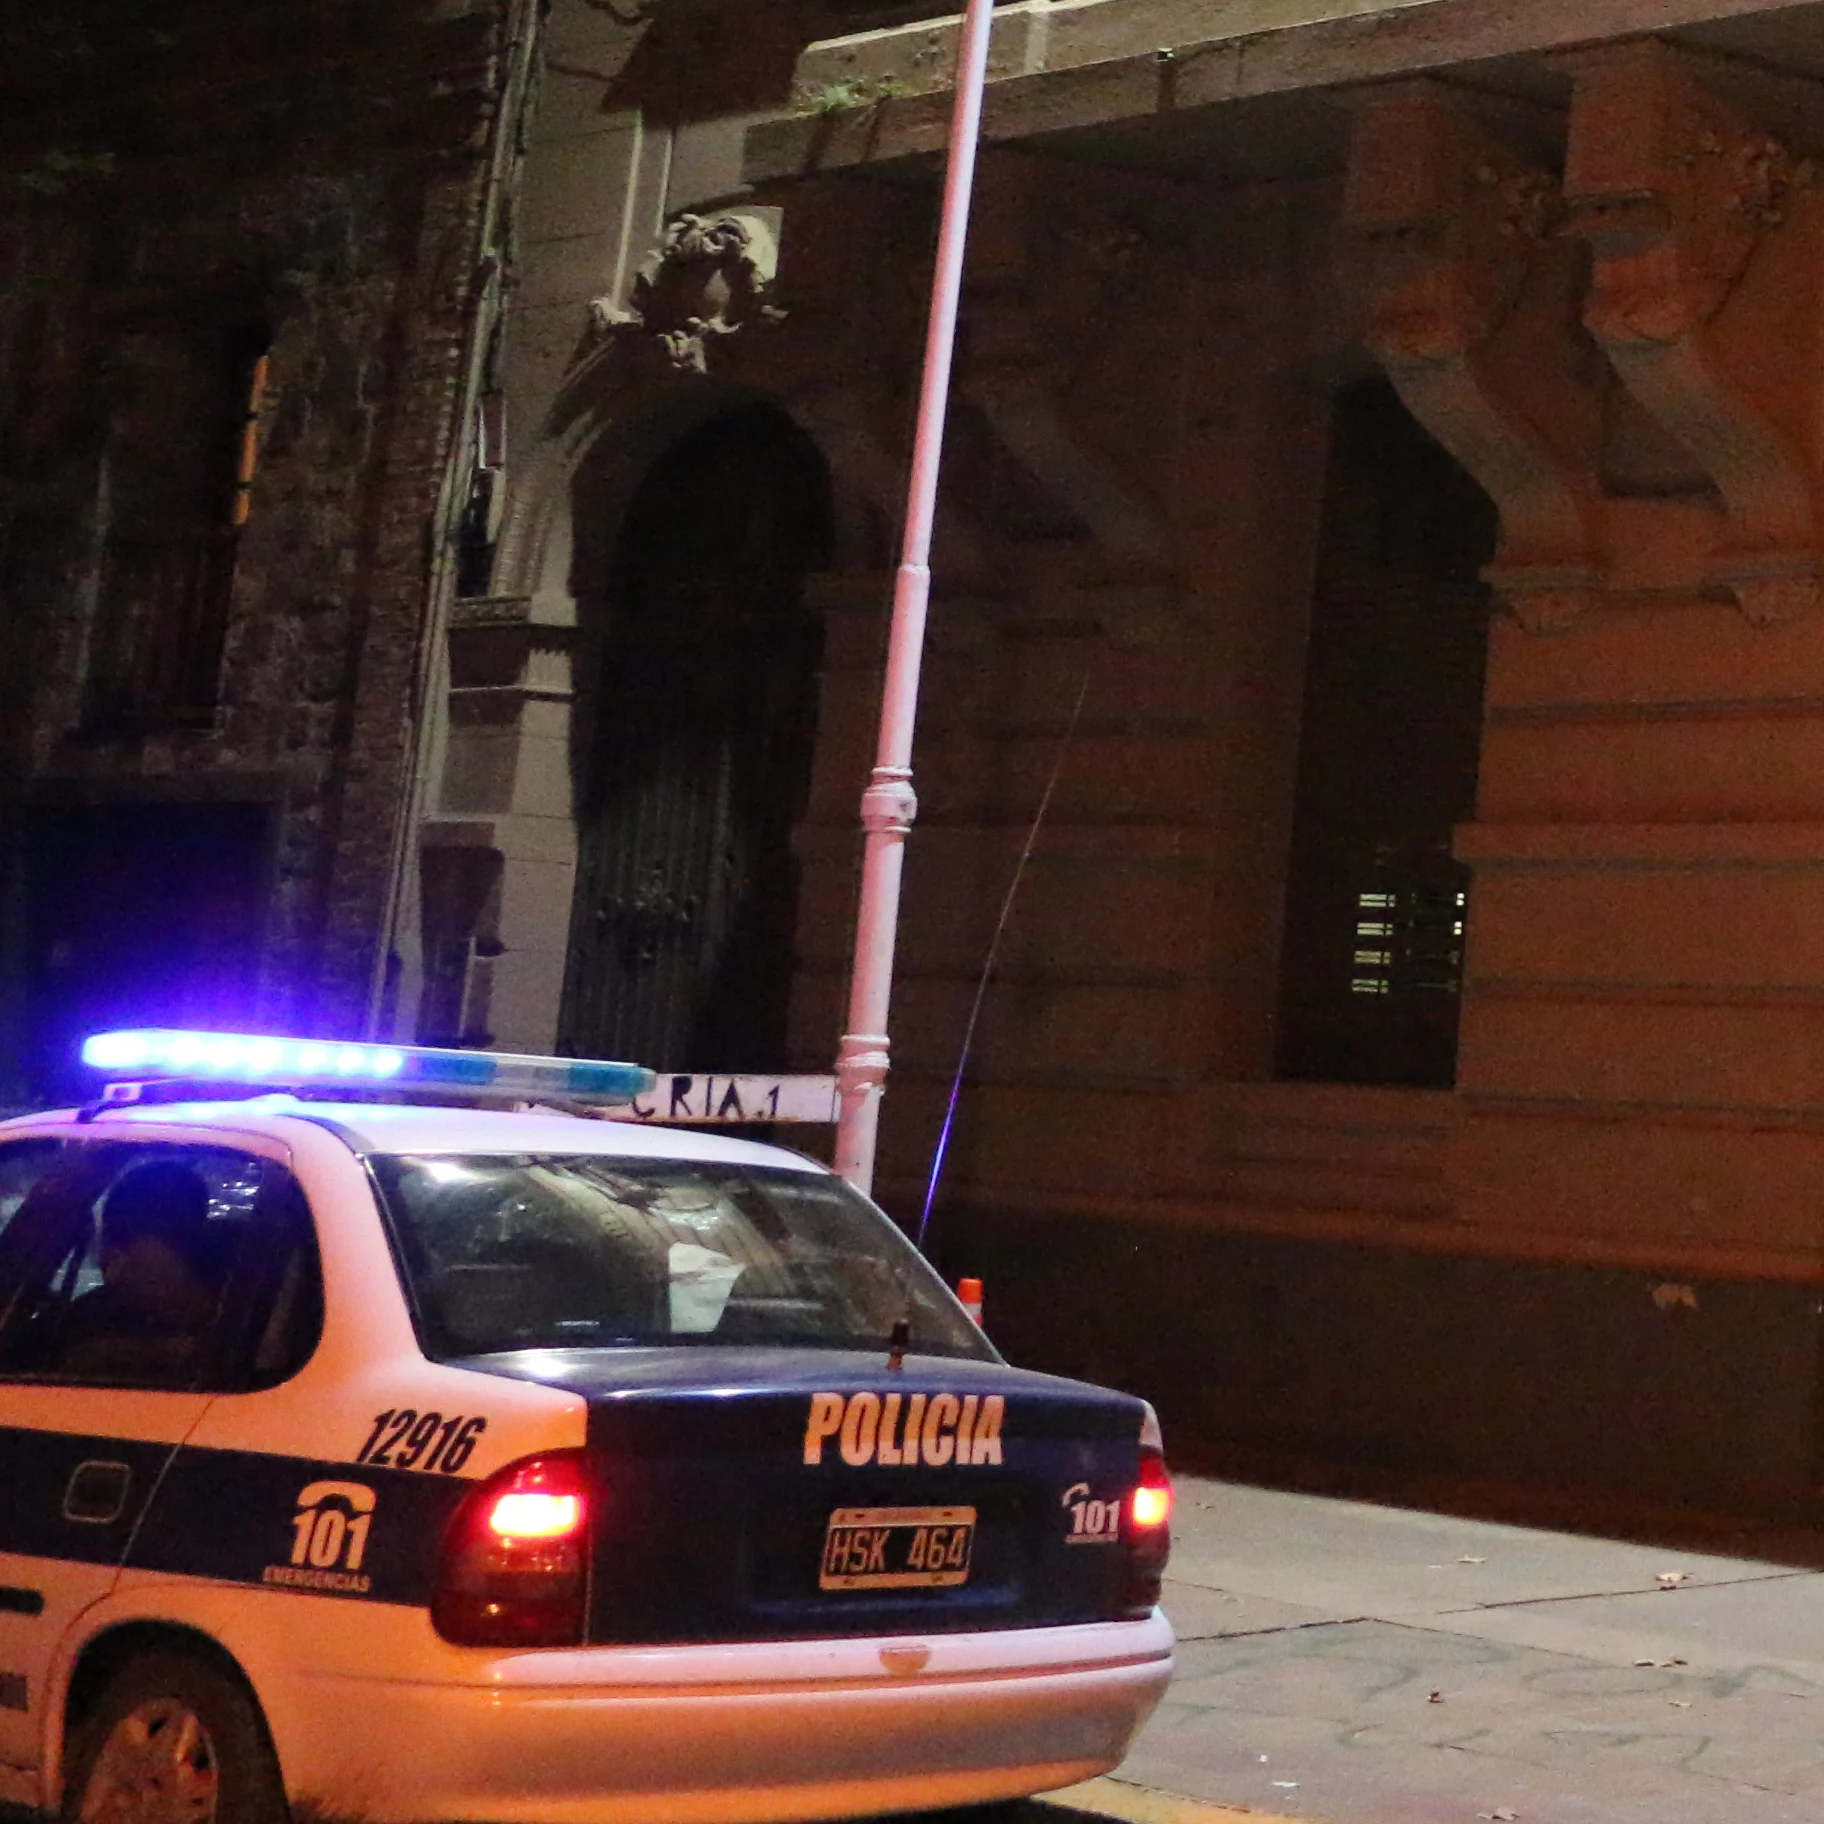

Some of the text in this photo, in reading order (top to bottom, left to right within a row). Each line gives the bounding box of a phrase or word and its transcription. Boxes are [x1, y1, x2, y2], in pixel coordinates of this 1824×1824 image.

[357, 1409, 488, 1474] 12916
[803, 1392, 1005, 1467] POLICIA
[291, 1509, 372, 1570] 101
[1070, 1500, 1121, 1534] 101
[828, 1527, 967, 1572] HSK 464
